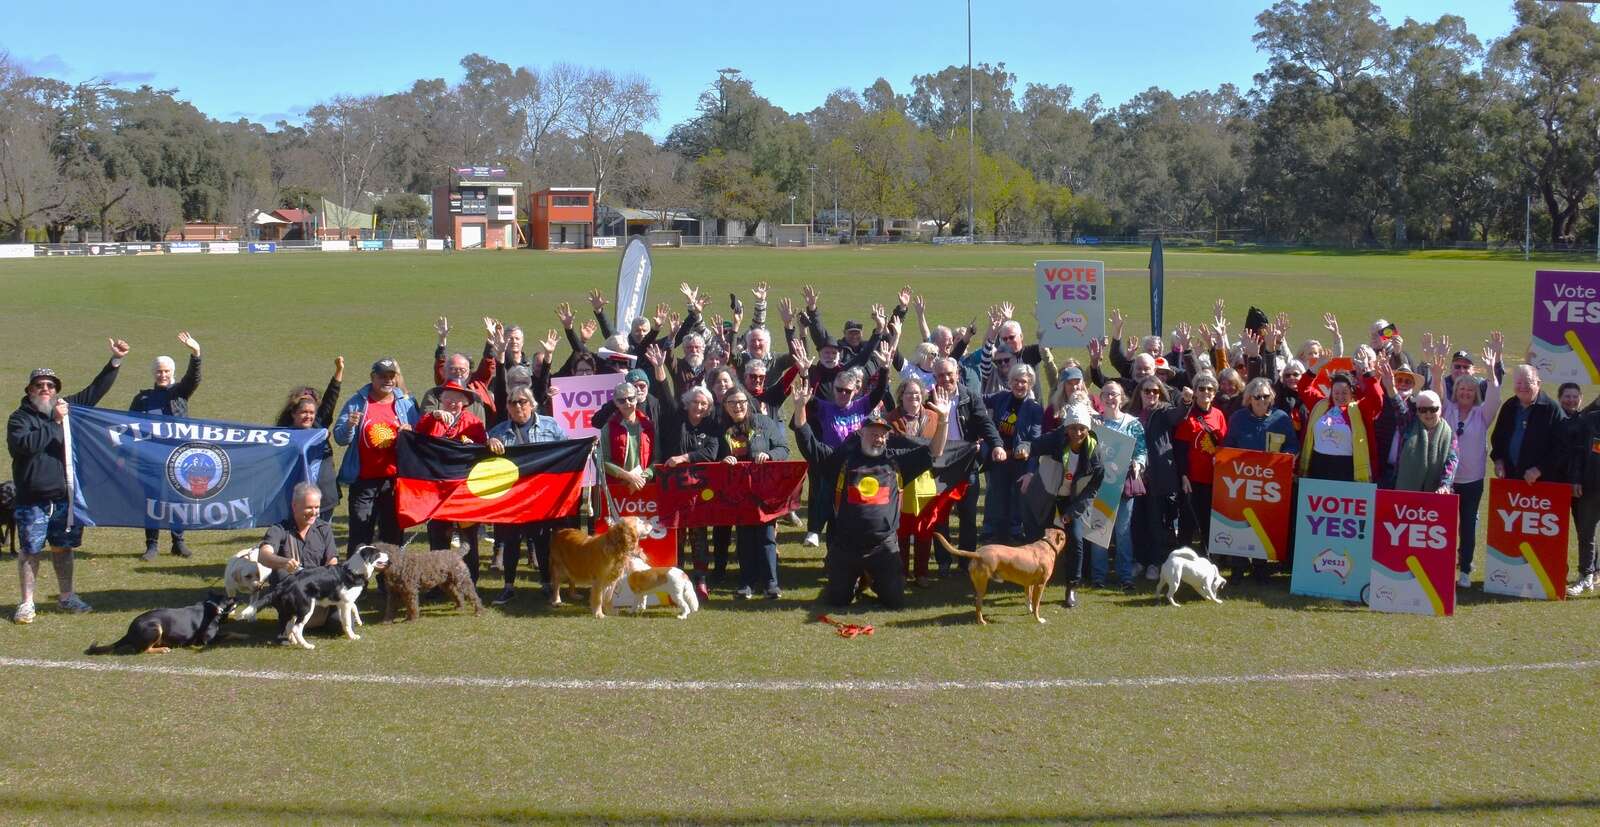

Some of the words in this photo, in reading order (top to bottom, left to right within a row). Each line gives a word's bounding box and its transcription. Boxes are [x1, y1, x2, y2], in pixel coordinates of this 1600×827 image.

[1044, 268, 1096, 282] VOTE
[1044, 284, 1096, 301] YES!
[1553, 283, 1596, 299] Vote
[1542, 300, 1600, 323] YES
[562, 409, 595, 429] YE
[108, 422, 291, 447] PLUMBERS
[654, 465, 708, 492] YES
[1233, 460, 1275, 479] Vote
[1222, 476, 1281, 503] YES
[146, 497, 253, 525] UNION
[614, 497, 657, 512] Vote
[1307, 495, 1368, 516] VOTE
[1507, 492, 1552, 510] Vote
[1394, 503, 1439, 522] Vote
[1497, 509, 1560, 536] YES
[1305, 515, 1367, 540] YES!
[1383, 521, 1448, 549] YES
